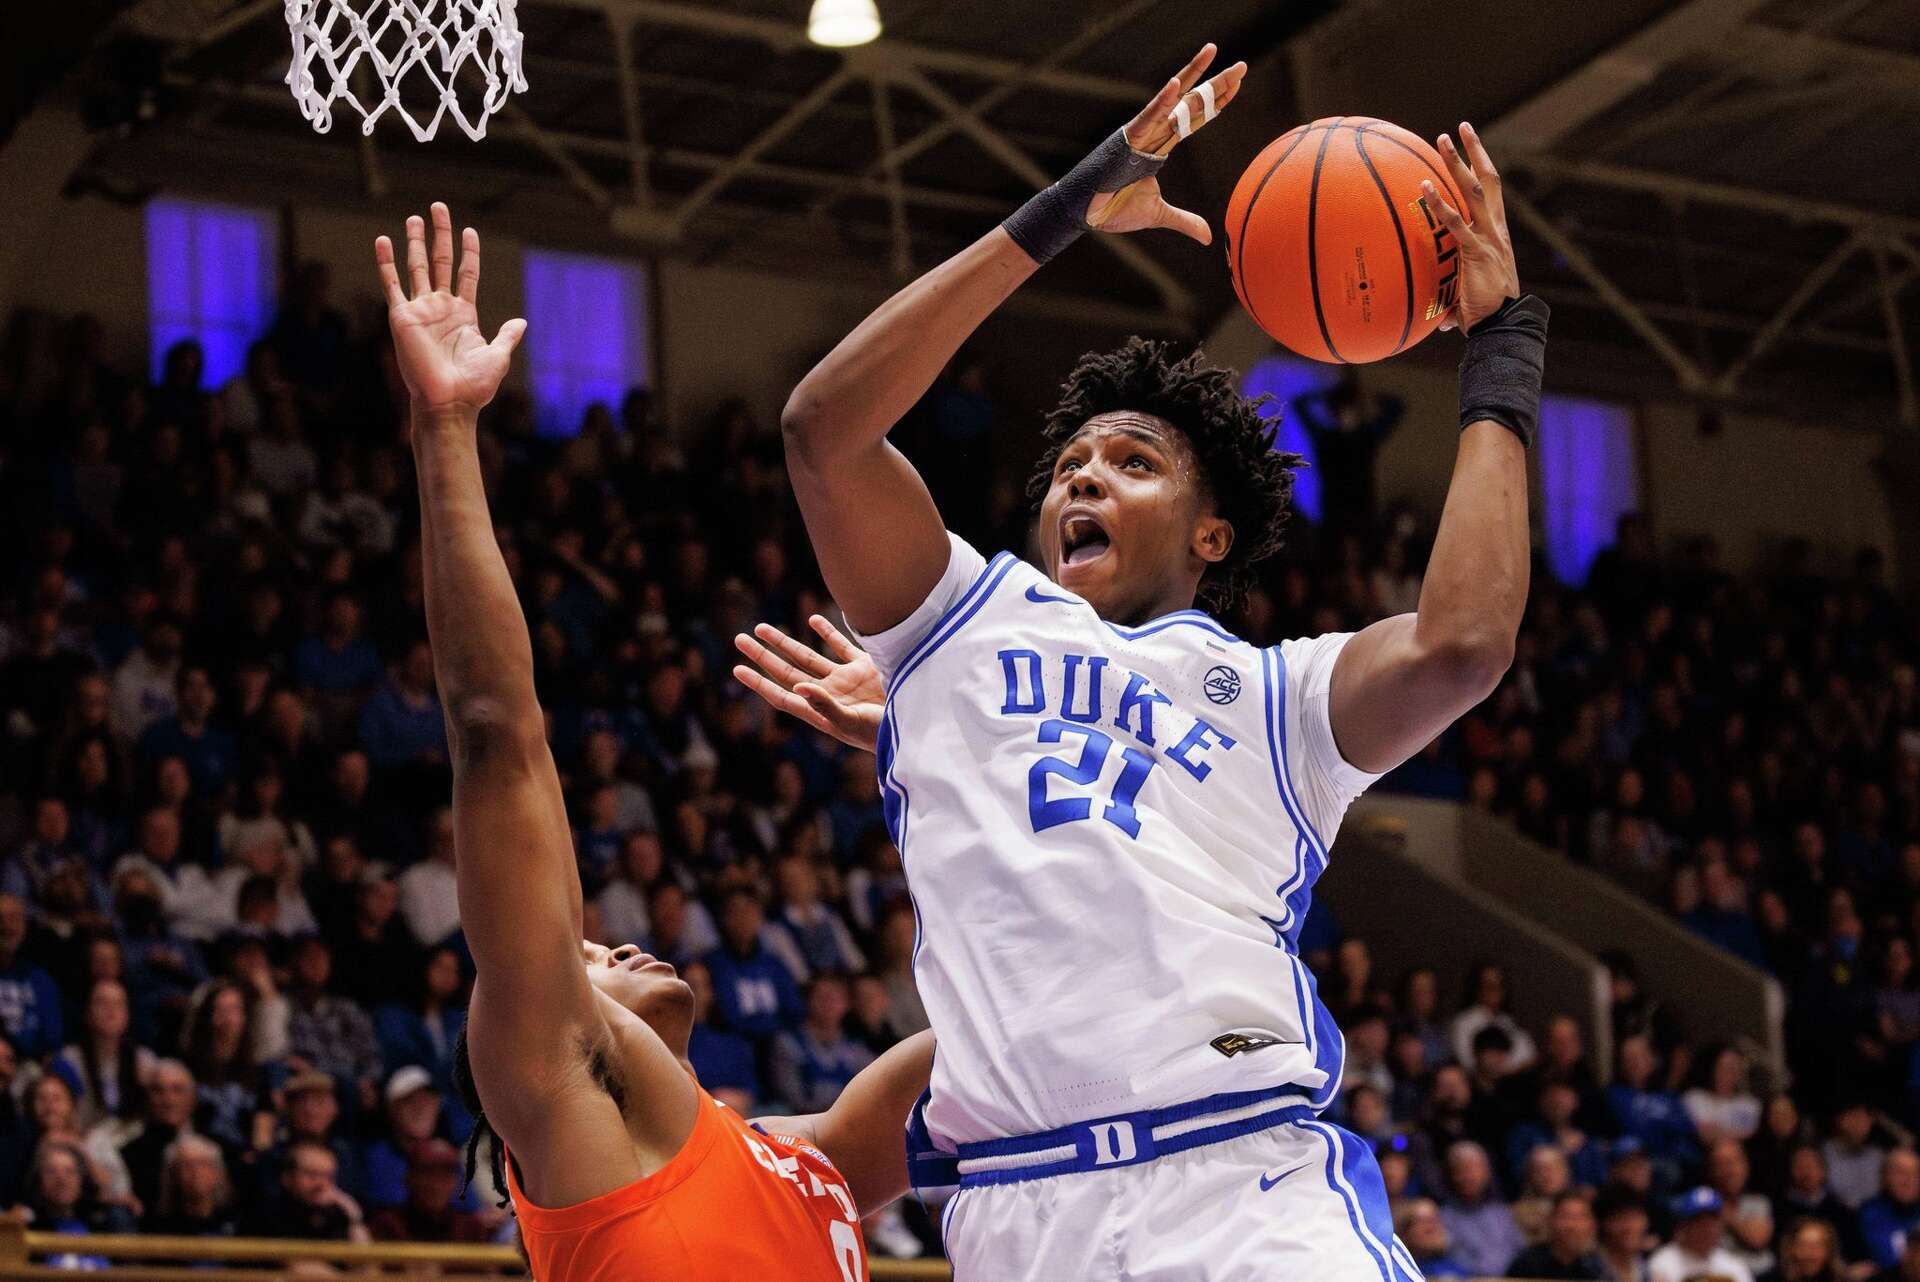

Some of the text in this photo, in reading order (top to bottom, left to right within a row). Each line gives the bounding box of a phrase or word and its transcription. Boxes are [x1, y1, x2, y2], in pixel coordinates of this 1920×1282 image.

[997, 649, 1237, 783] DUKE
[1206, 677, 1240, 694] ACC
[1028, 718, 1156, 841] 21
[1089, 1120, 1137, 1165] D
